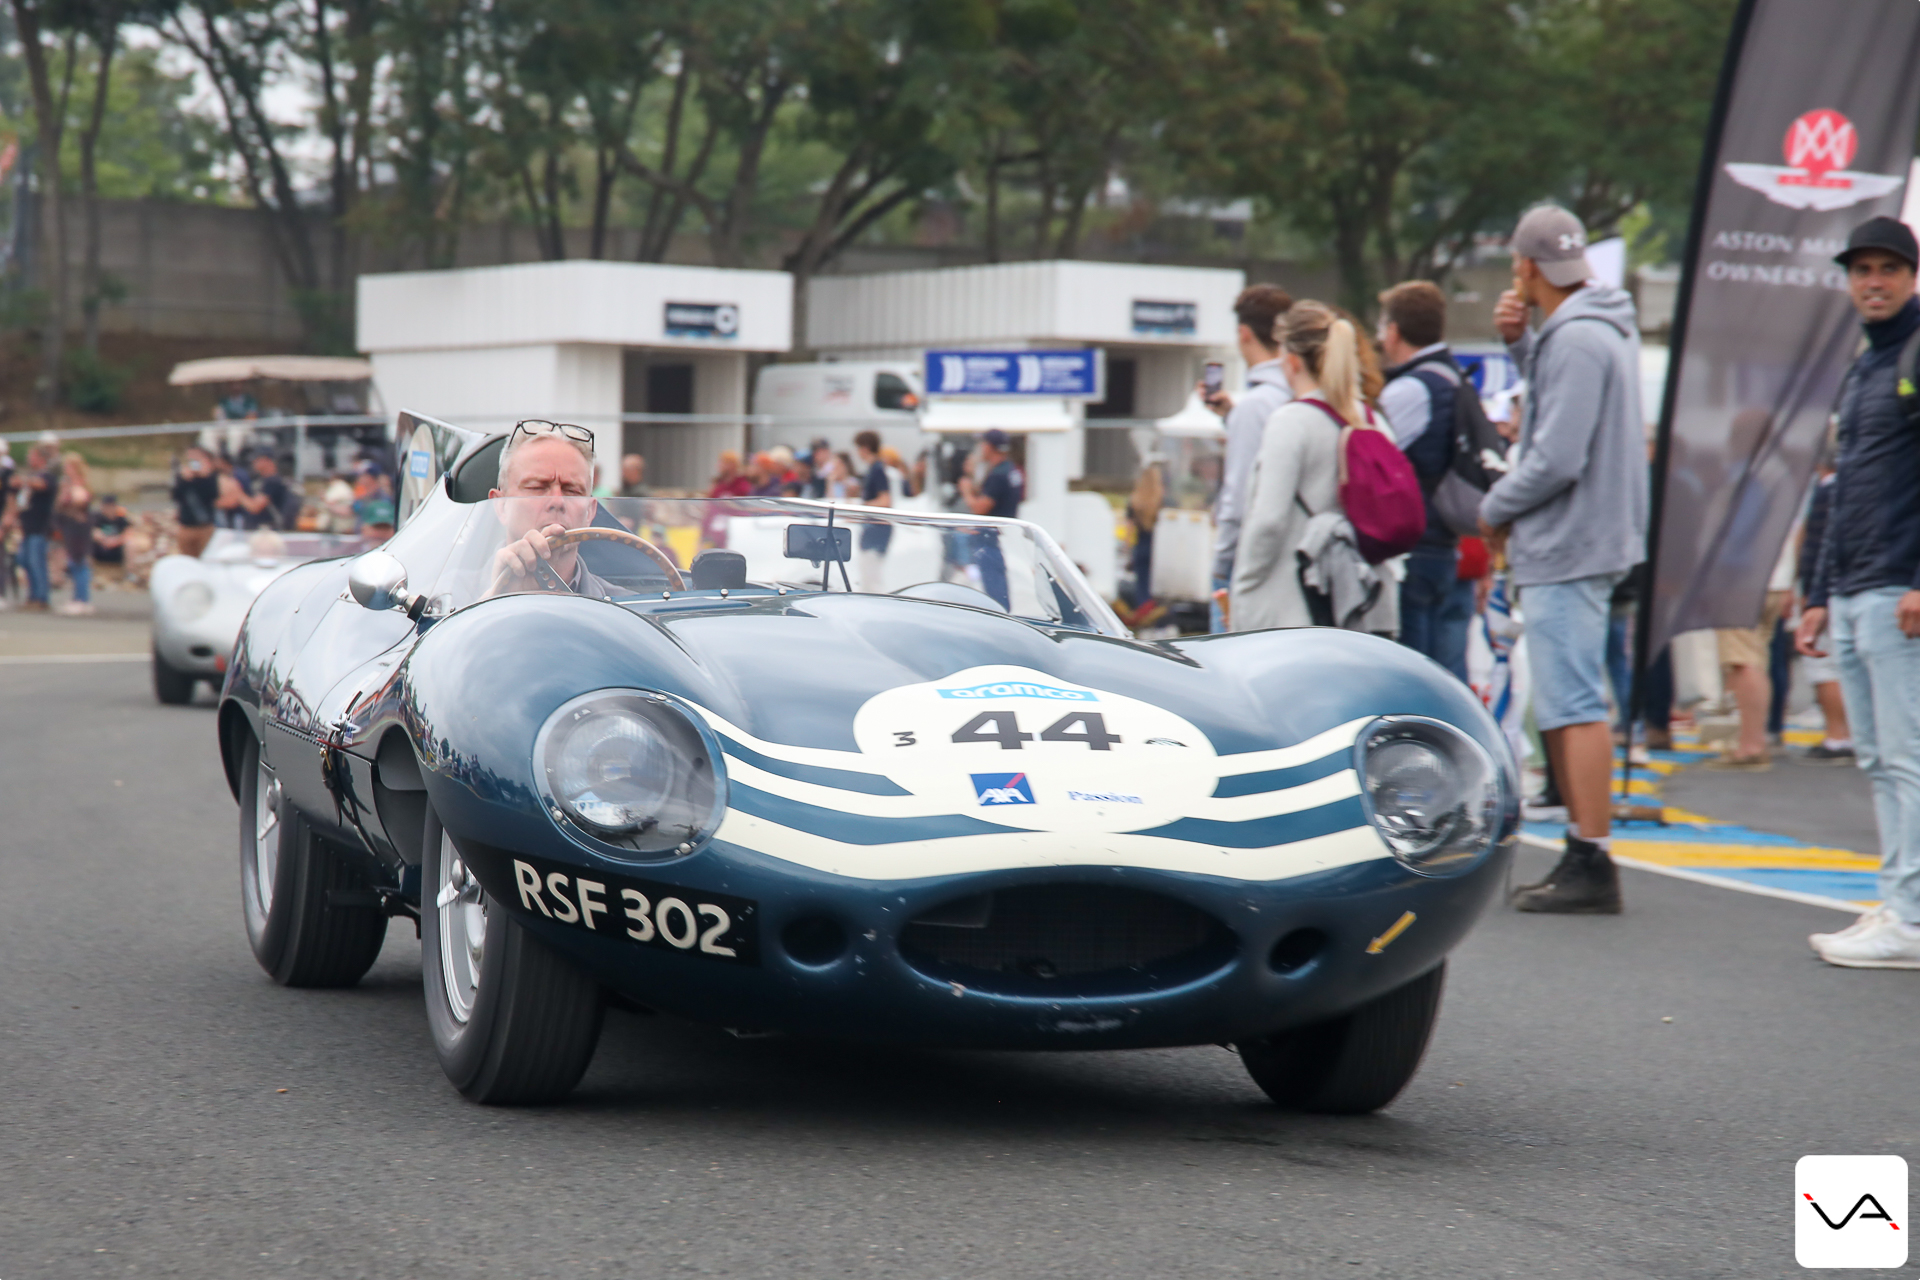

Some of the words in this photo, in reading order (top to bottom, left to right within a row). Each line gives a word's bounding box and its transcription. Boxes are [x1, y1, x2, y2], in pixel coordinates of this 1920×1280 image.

[1712, 230, 1793, 253] ASTON
[1707, 260, 1816, 287] OWNERS
[951, 684, 1085, 699] aramco
[893, 731, 916, 747] 3
[951, 711, 1121, 750] 44
[978, 787, 1030, 803] AXA
[513, 858, 608, 930] RSF
[620, 888, 737, 958] 302
